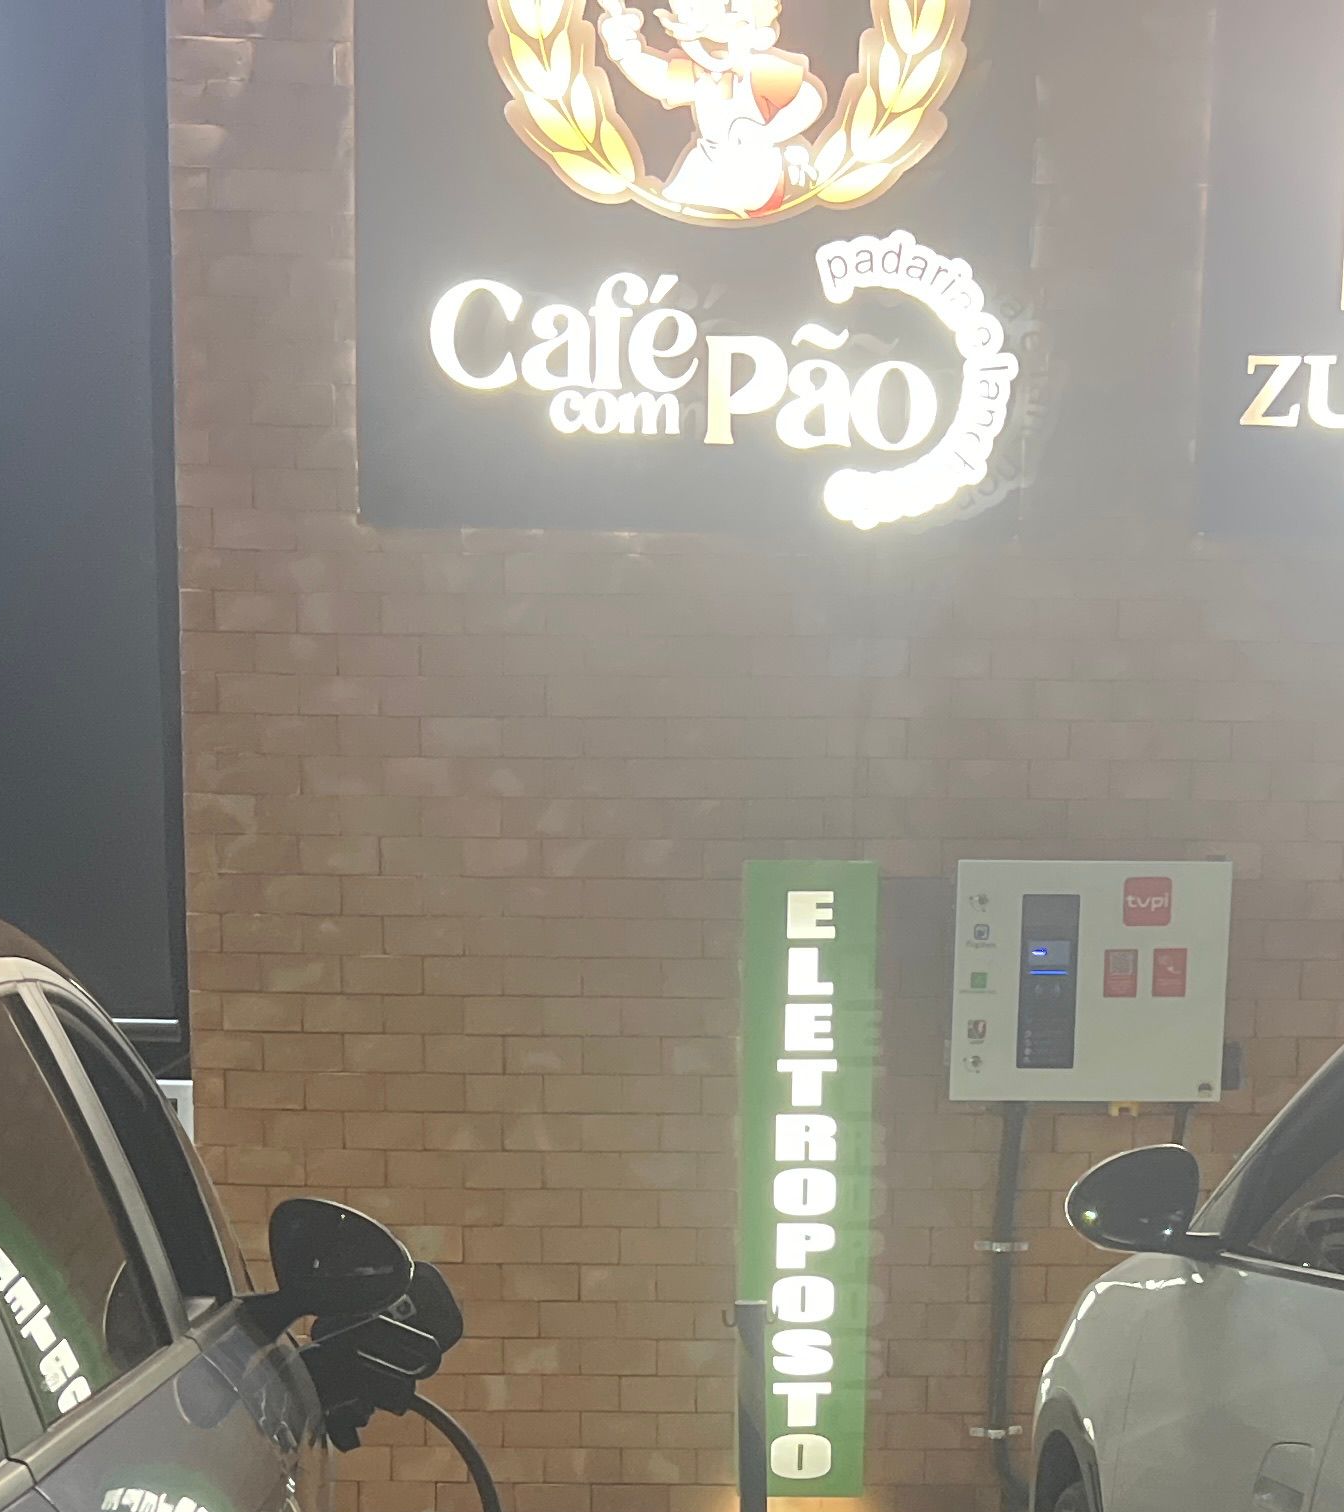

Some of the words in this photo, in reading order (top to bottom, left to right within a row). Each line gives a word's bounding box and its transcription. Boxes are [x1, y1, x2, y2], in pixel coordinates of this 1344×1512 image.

[429, 272, 699, 392] Café
[704, 323, 937, 451] Pão
[549, 390, 681, 436] com
[770, 890, 838, 1480] ELETROPOSTO
